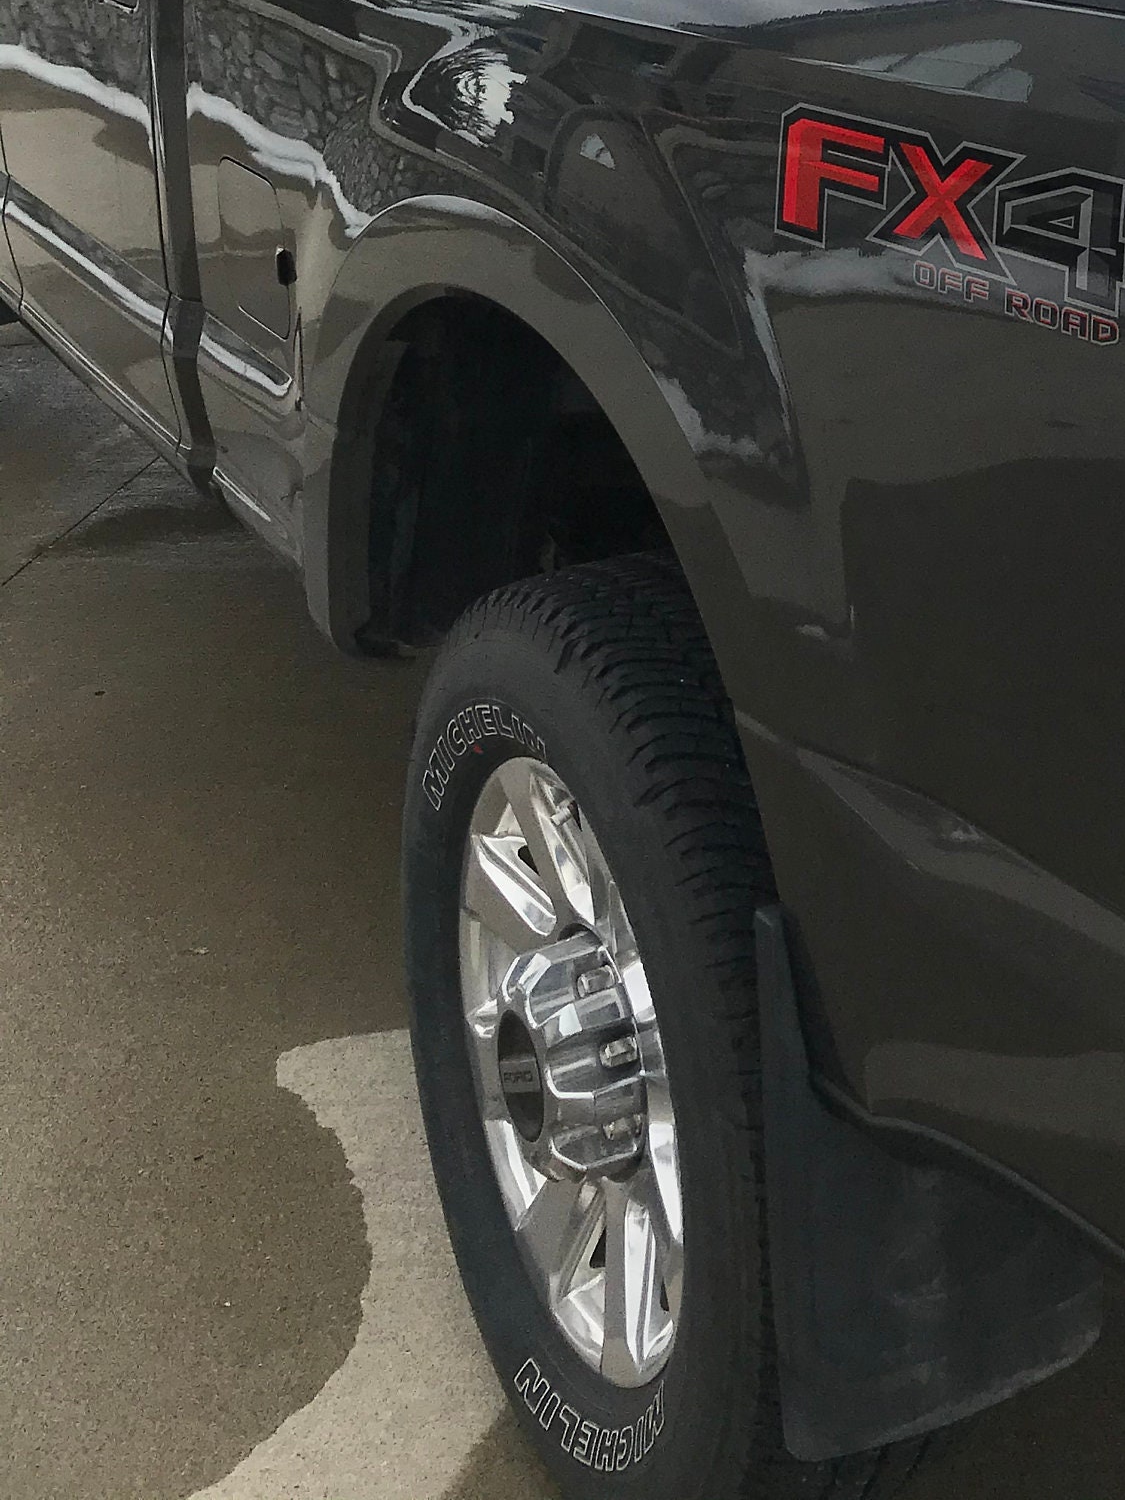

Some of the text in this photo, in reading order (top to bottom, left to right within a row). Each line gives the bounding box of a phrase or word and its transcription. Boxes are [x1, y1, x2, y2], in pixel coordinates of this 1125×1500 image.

[913, 260, 1120, 346] OFF ROAD
[422, 704, 547, 811] MICHELIN
[513, 1357, 665, 1472] MICHELIN
